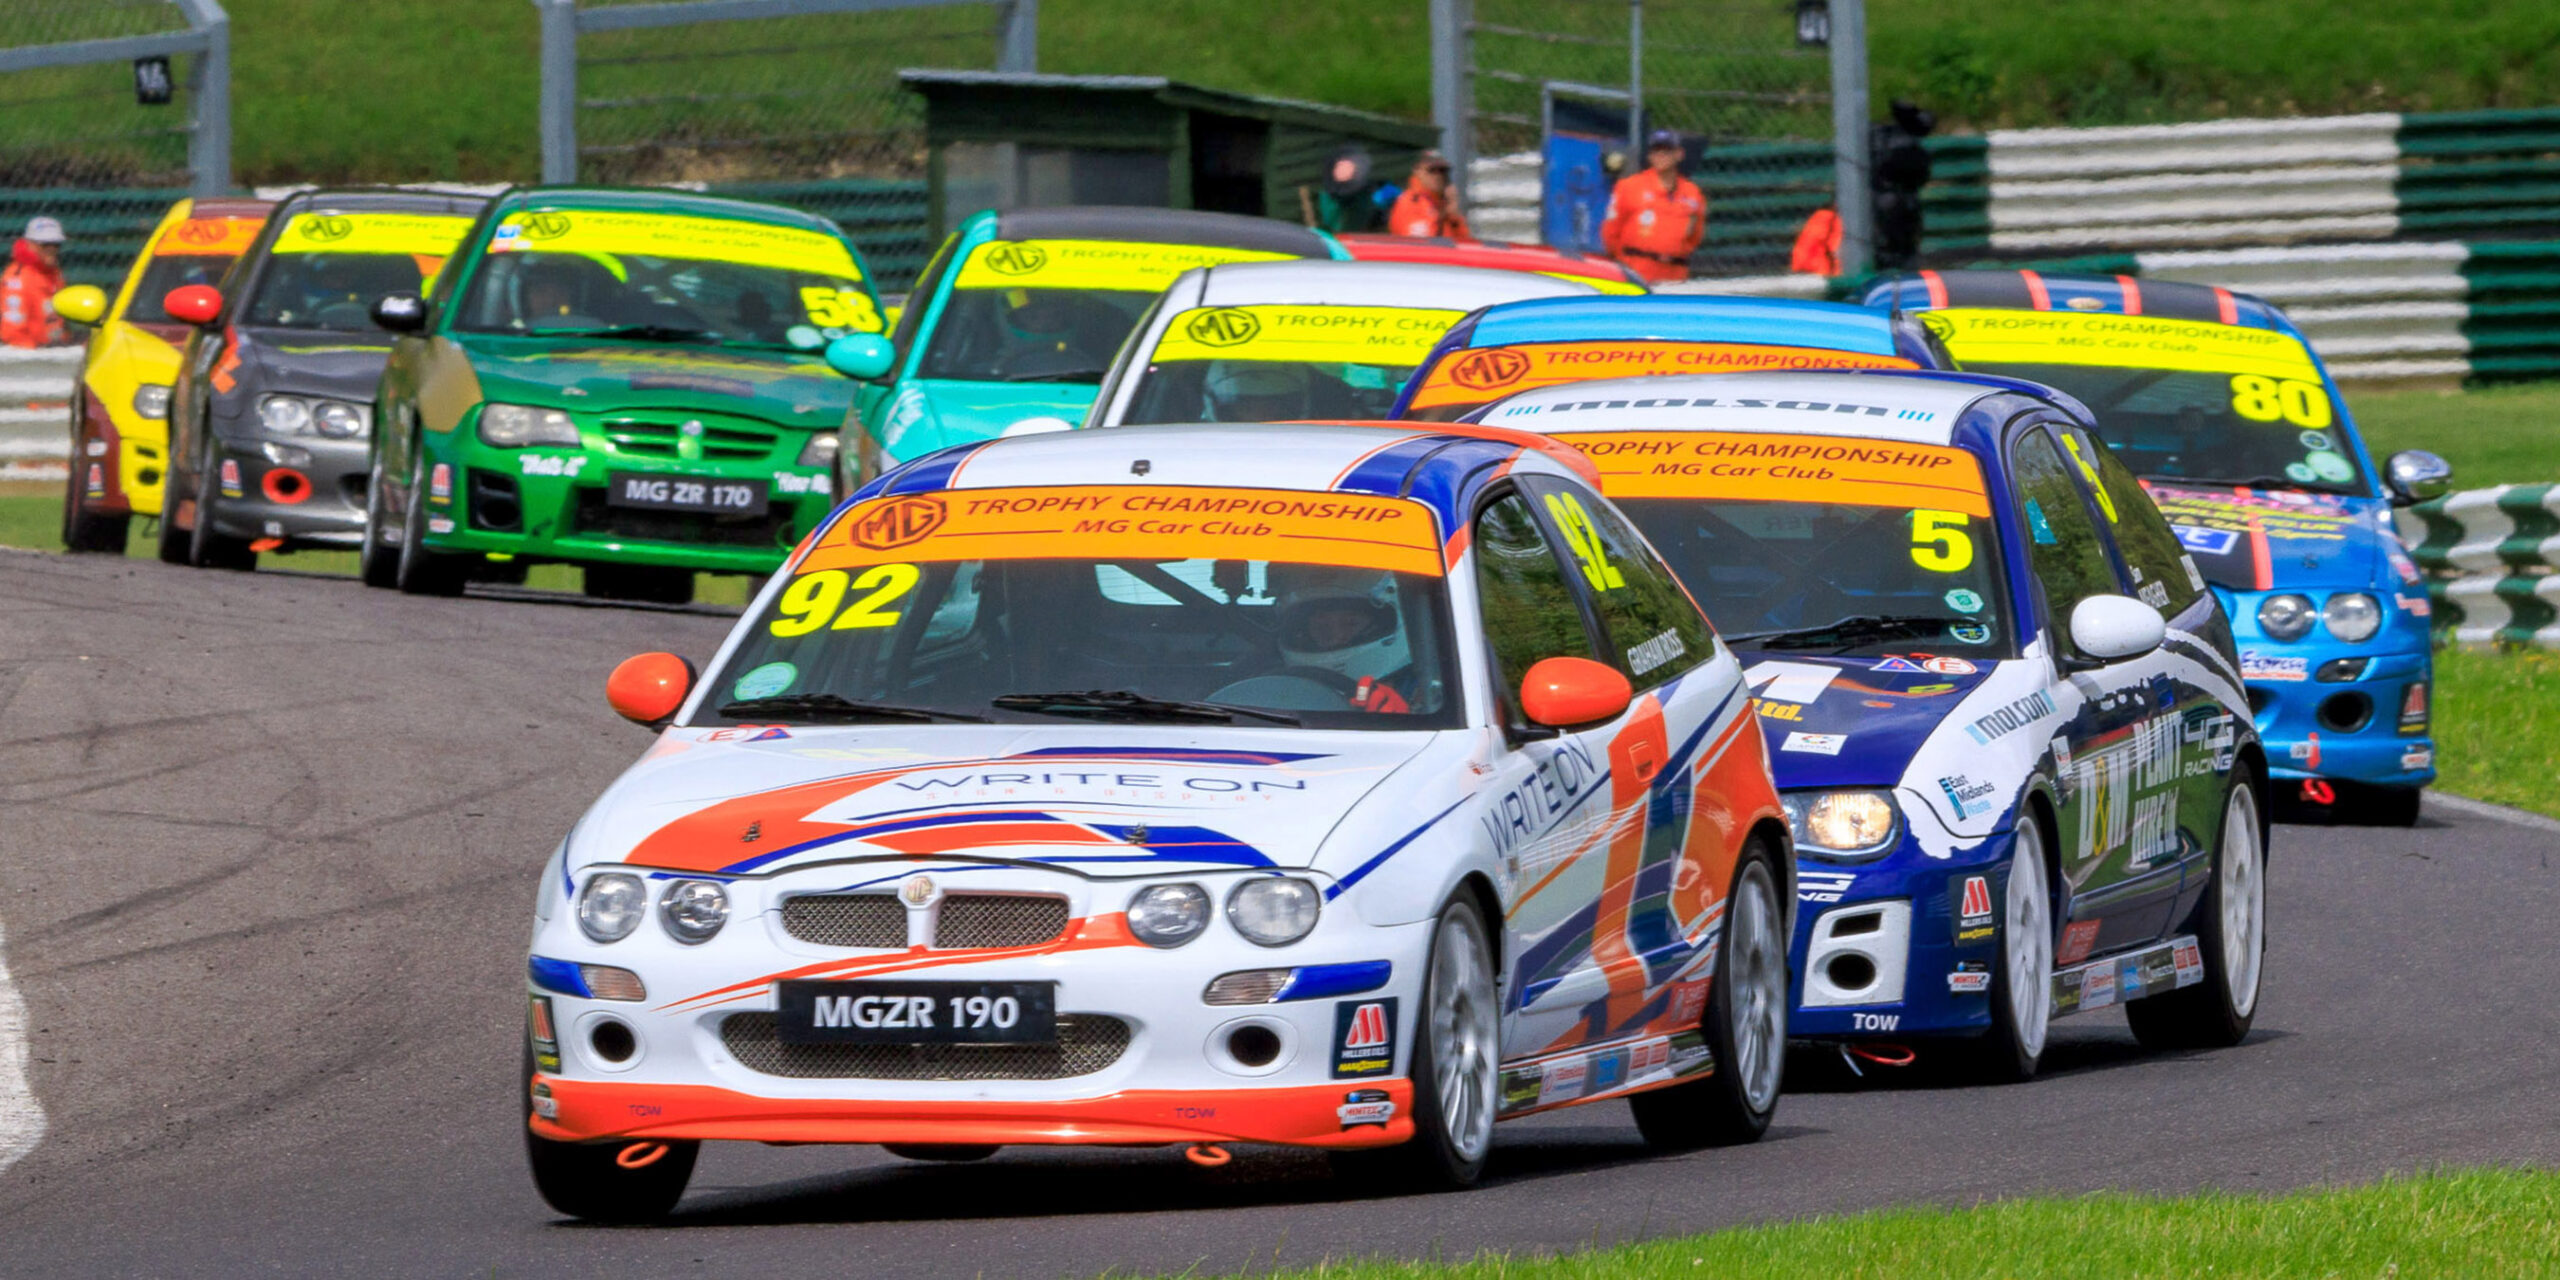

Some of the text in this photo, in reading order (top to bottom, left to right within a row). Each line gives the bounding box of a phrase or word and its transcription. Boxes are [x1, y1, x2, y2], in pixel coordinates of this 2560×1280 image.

[523, 212, 566, 238] MG
[988, 243, 1043, 273] MG
[1060, 248, 1154, 261] TROPHY
[799, 287, 883, 333] 58
[1275, 314, 1386, 329] TROPHY
[1191, 310, 1256, 343] MG
[1366, 335, 1407, 346] MG
[1967, 317, 2283, 347] TROPHY CHAMPIONSHIP
[2056, 336, 2200, 352] MG Car Club
[1458, 350, 1527, 387] MG
[1545, 350, 1898, 370] TROPHY CHAMPIONS
[2230, 373, 2332, 429] 80
[1572, 440, 1954, 471] ROPHY CHAMPIONSHIP
[1650, 461, 1835, 481] MG Car Club
[2061, 432, 2119, 524] 5
[625, 479, 753, 507] MG ZR 170
[854, 498, 942, 549] MG
[963, 495, 1403, 524] TROPHY CHAMPIONSHIP
[1071, 519, 1274, 539] MG Car Club
[1544, 491, 1627, 592] 92
[1910, 508, 1974, 573] 5
[769, 563, 921, 638] 92
[2132, 709, 2184, 792] PLANT
[2183, 753, 2233, 778] RACING
[896, 773, 1307, 793] WRITE ON
[1481, 733, 1596, 860] WRITE ON
[813, 995, 1020, 1029] MGZR 190
[1852, 1012, 1900, 1031] TOW
[628, 1104, 663, 1117] TOW
[1175, 1106, 1217, 1120] TOW
